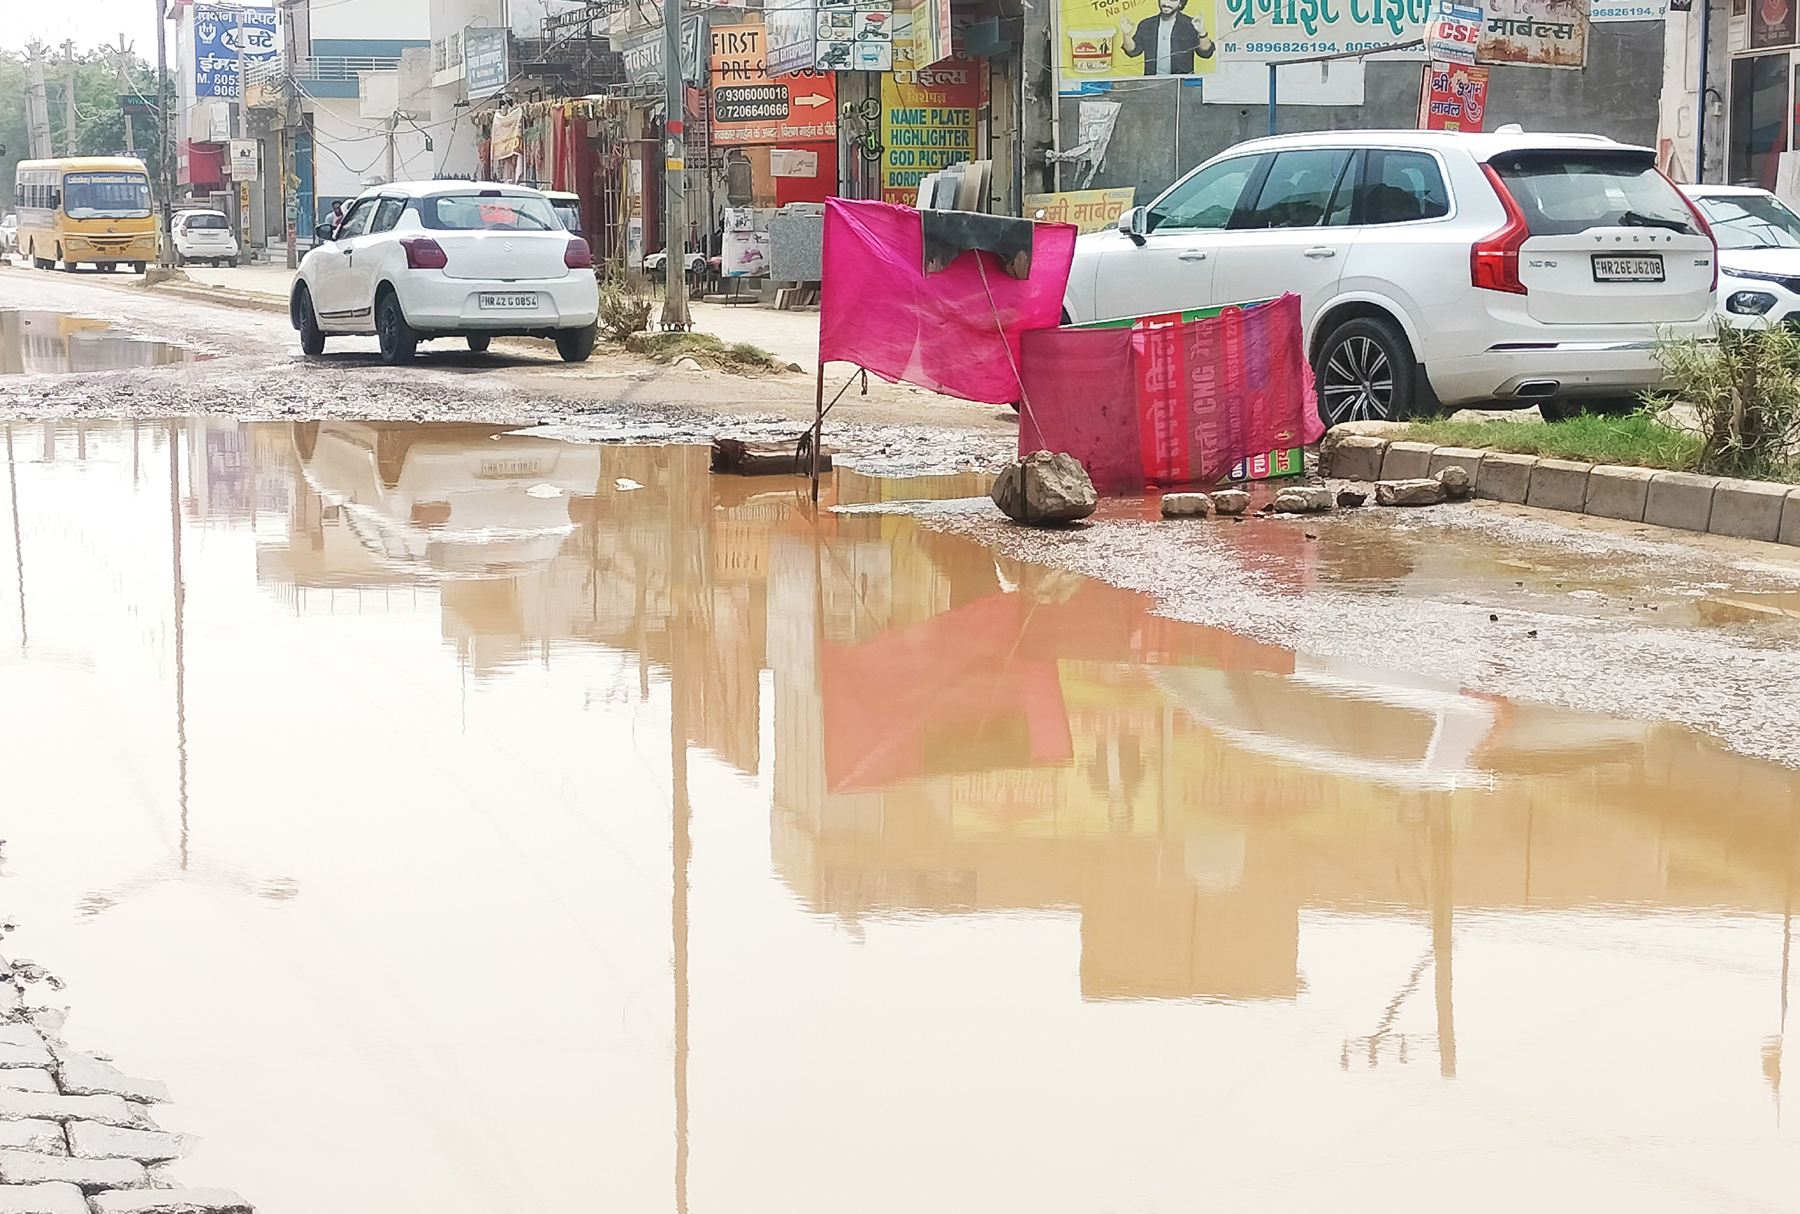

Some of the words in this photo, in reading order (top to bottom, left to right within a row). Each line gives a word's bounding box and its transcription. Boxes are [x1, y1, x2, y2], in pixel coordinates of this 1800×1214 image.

[1105, 7, 1120, 17] Na
[248, 31, 274, 48] घंटे
[1439, 22, 1480, 44] CSE
[711, 31, 759, 56] FIRST
[721, 59, 752, 81] PRE
[1432, 73, 1450, 92] श्री
[725, 87, 788, 102] 9306000018
[727, 103, 789, 118] 7206640666
[890, 109, 927, 125] NAME
[930, 109, 970, 126] PLATE
[890, 129, 970, 147] HIGHLIGHTER
[889, 150, 915, 167] GOD
[1601, 260, 1661, 275] HR26EJ6208
[1192, 364, 1217, 415] CNG
